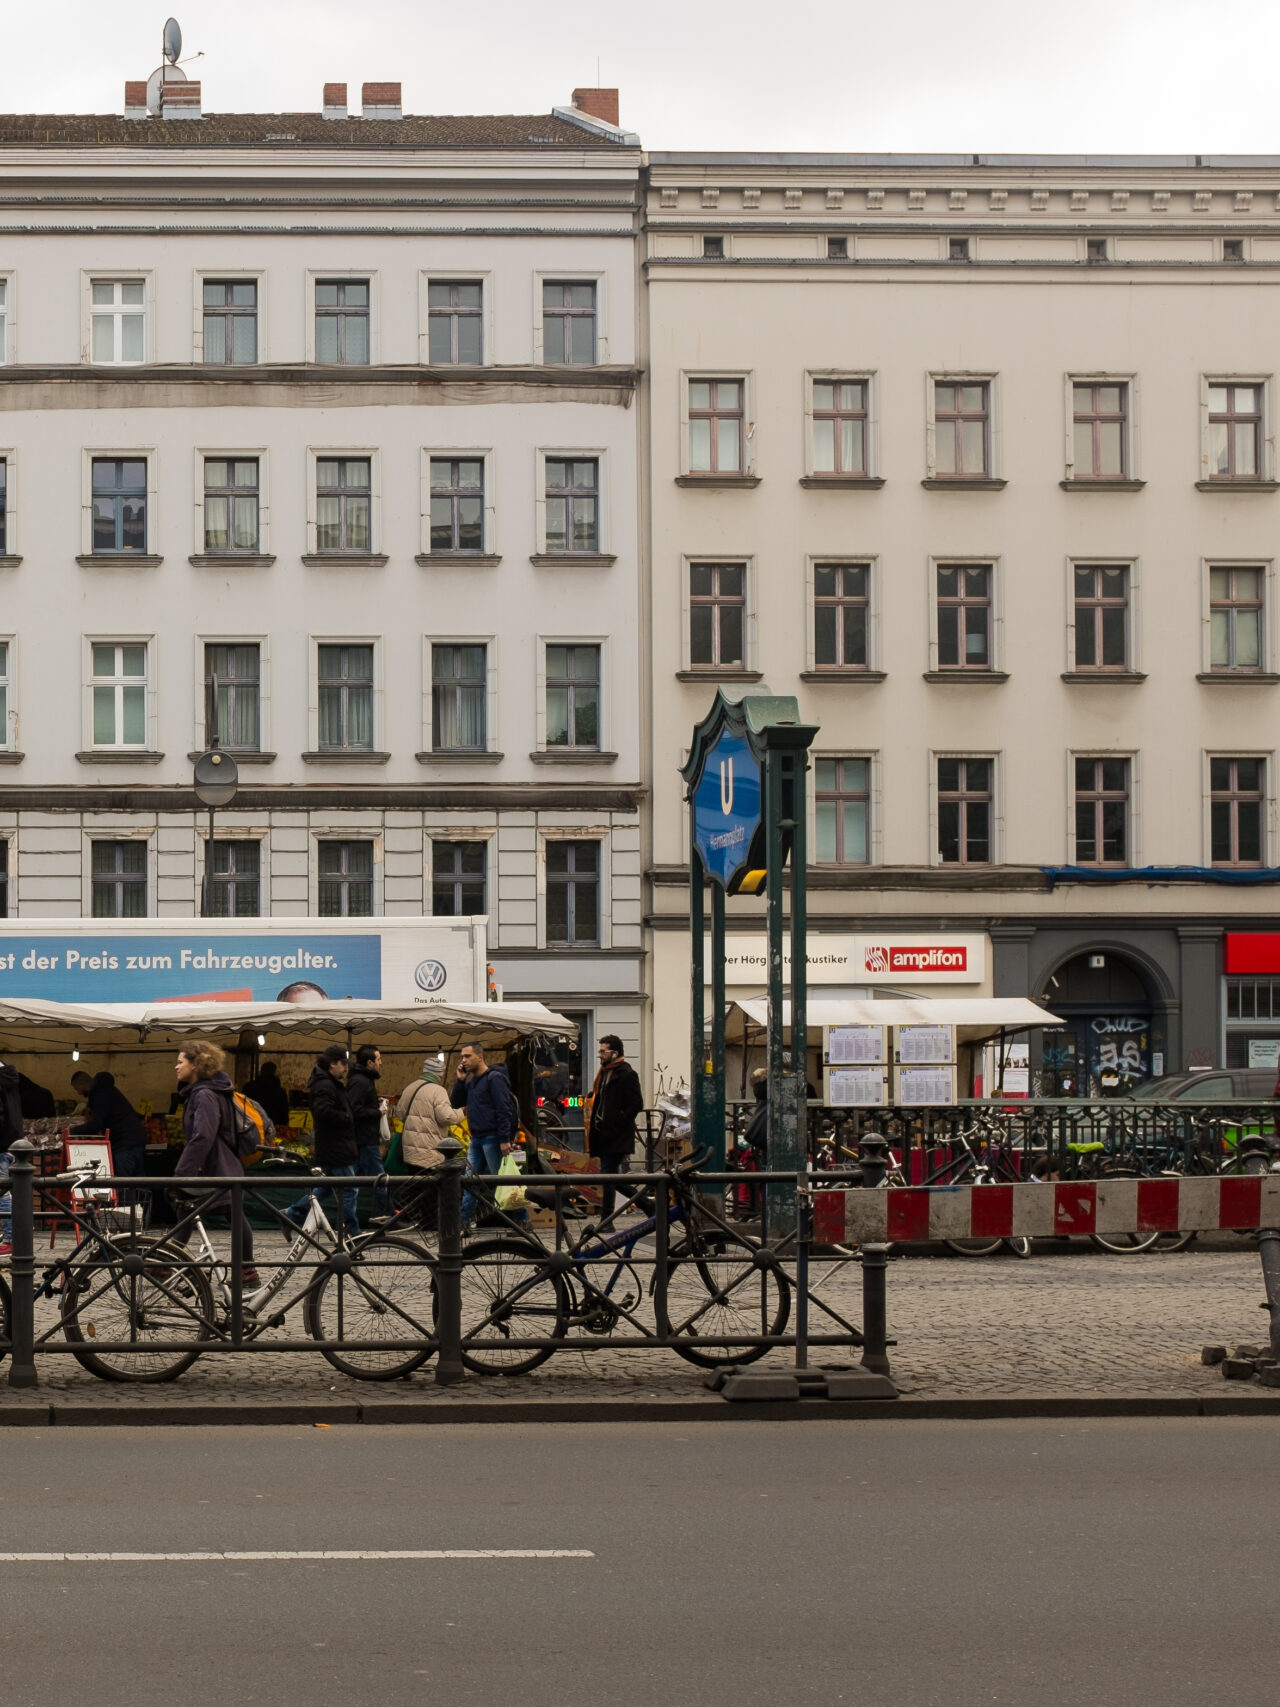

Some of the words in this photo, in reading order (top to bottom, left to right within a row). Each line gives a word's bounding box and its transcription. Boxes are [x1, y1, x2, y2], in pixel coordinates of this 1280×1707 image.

[720, 757, 733, 815] U
[22, 949, 58, 970] der
[66, 950, 118, 970] Preis
[126, 955, 172, 969] zum
[180, 949, 338, 974] Fahrzeugalter.
[893, 950, 963, 968] amplifon
